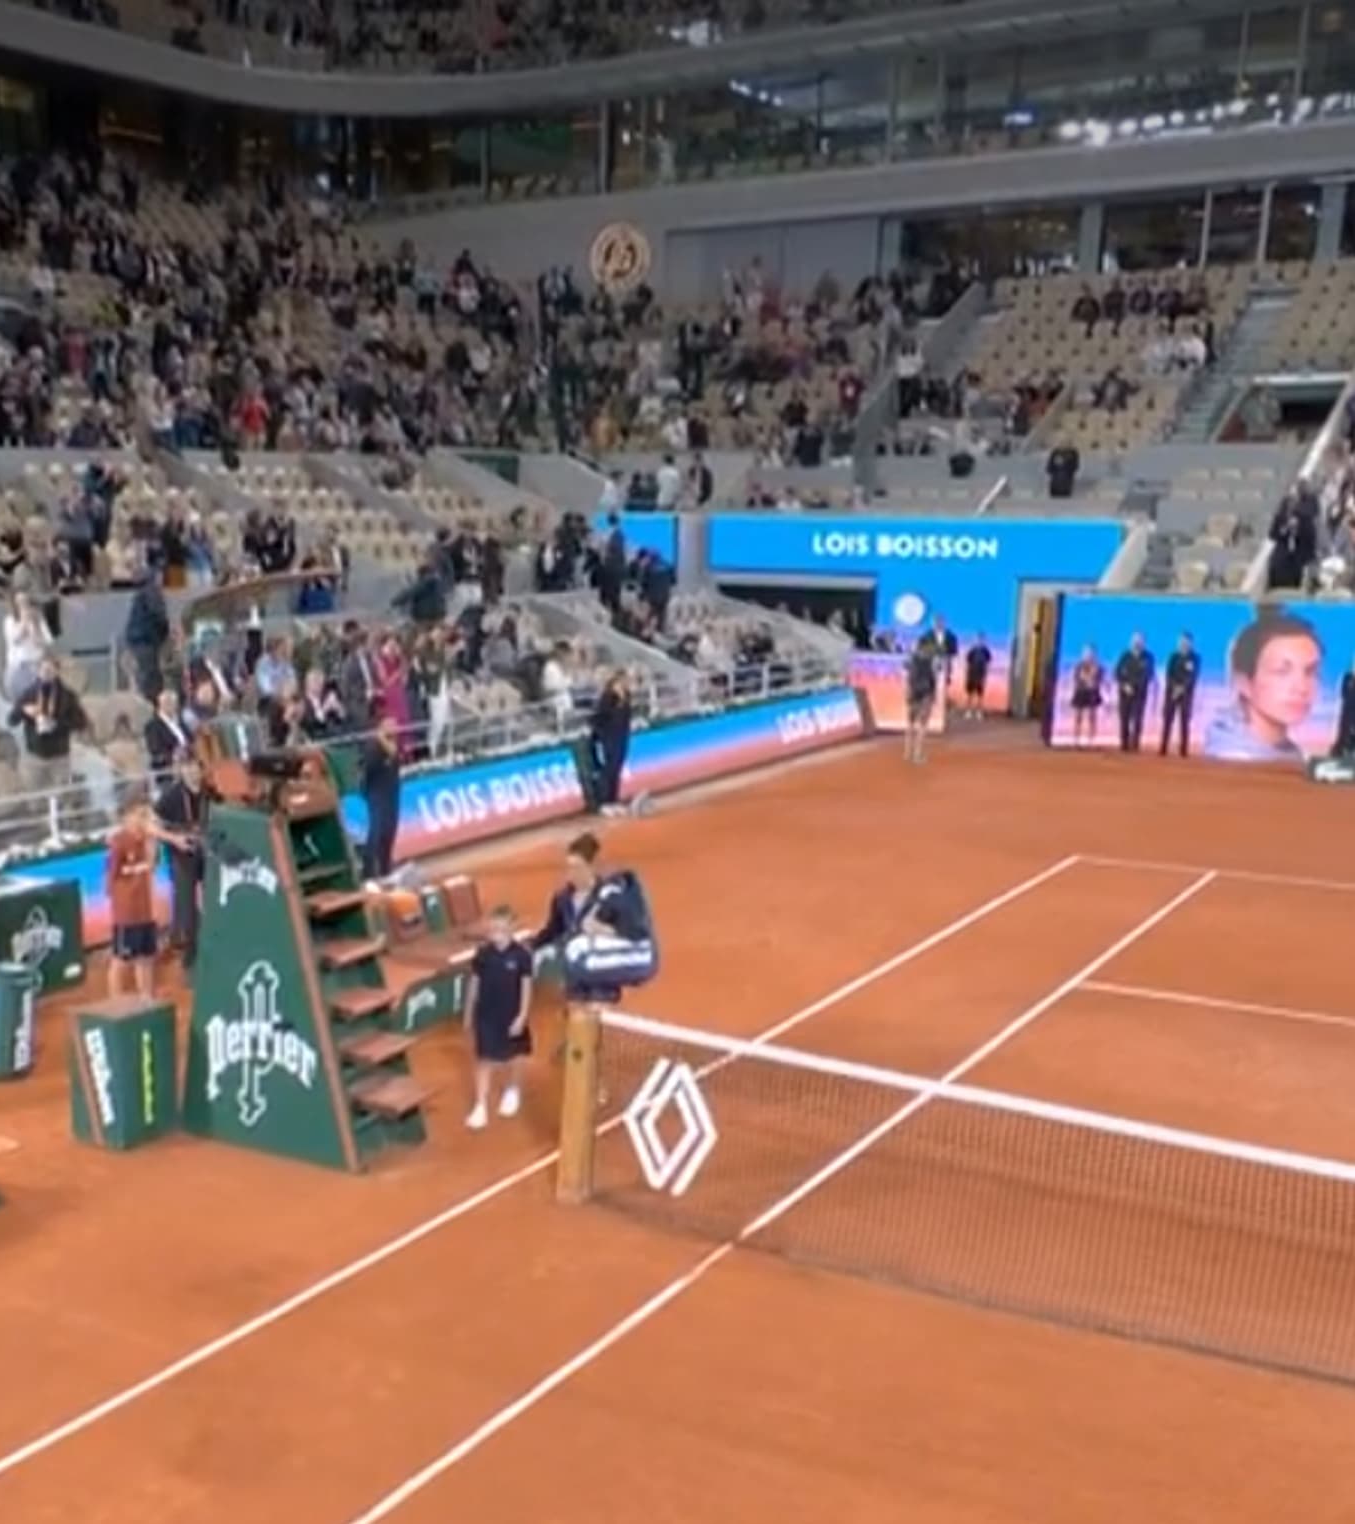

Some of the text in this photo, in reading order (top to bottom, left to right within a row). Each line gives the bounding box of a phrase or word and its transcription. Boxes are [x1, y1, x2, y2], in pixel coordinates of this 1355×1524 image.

[812, 533, 998, 558] LOIS BOISSON
[418, 783, 487, 832] LOIS
[205, 1012, 317, 1101] Perrier
